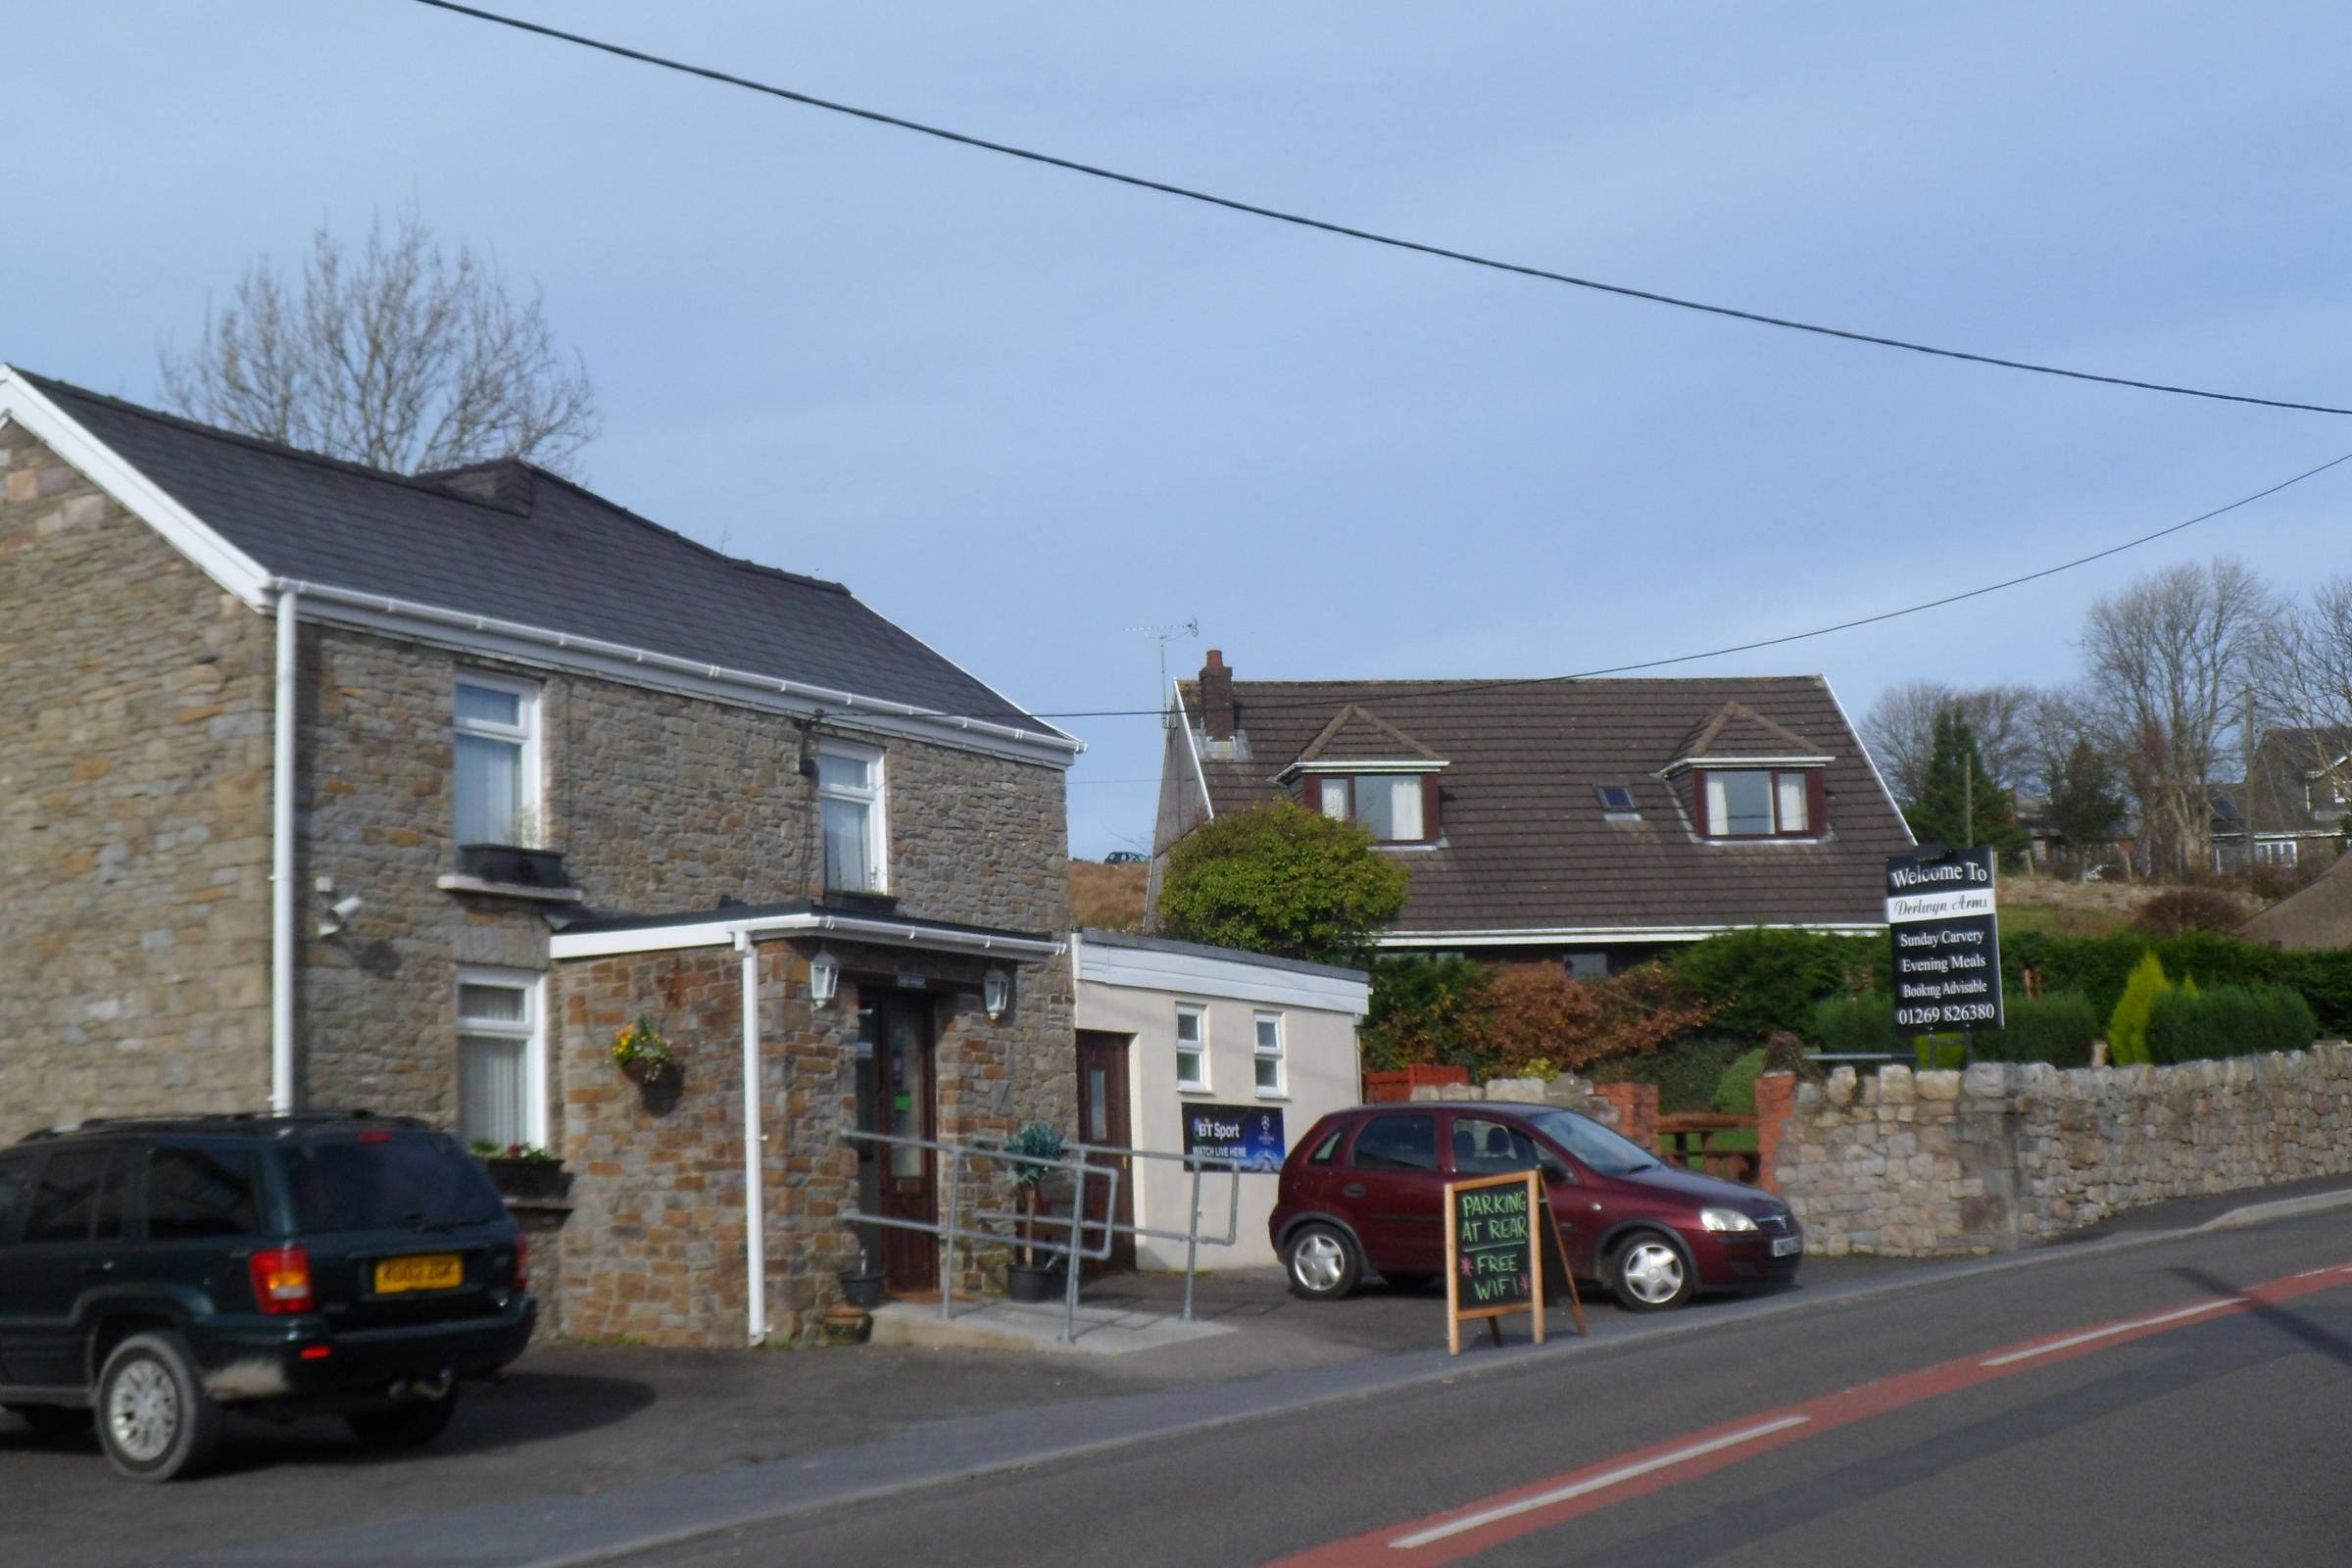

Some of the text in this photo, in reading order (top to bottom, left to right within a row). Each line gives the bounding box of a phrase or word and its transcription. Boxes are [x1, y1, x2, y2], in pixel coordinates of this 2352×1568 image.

[1892, 862, 1987, 888] Welcome To
[1952, 895, 1987, 910] Arms
[1900, 930, 1984, 948] Sunday Carvery
[1902, 955, 1986, 973] Evening Meals
[1903, 980, 1987, 1000] Booking Advisable
[1898, 1003, 1995, 1025] 01269 826380
[1199, 1123, 1213, 1138] BT
[1214, 1121, 1240, 1141] Sport
[1192, 1146, 1215, 1157] WATCH
[1215, 1146, 1229, 1157] LIVE
[1462, 1191, 1528, 1217] PARKING
[1462, 1216, 1529, 1243] AT REAR
[1477, 1253, 1518, 1275] FREE
[1474, 1278, 1519, 1300] WIFI
